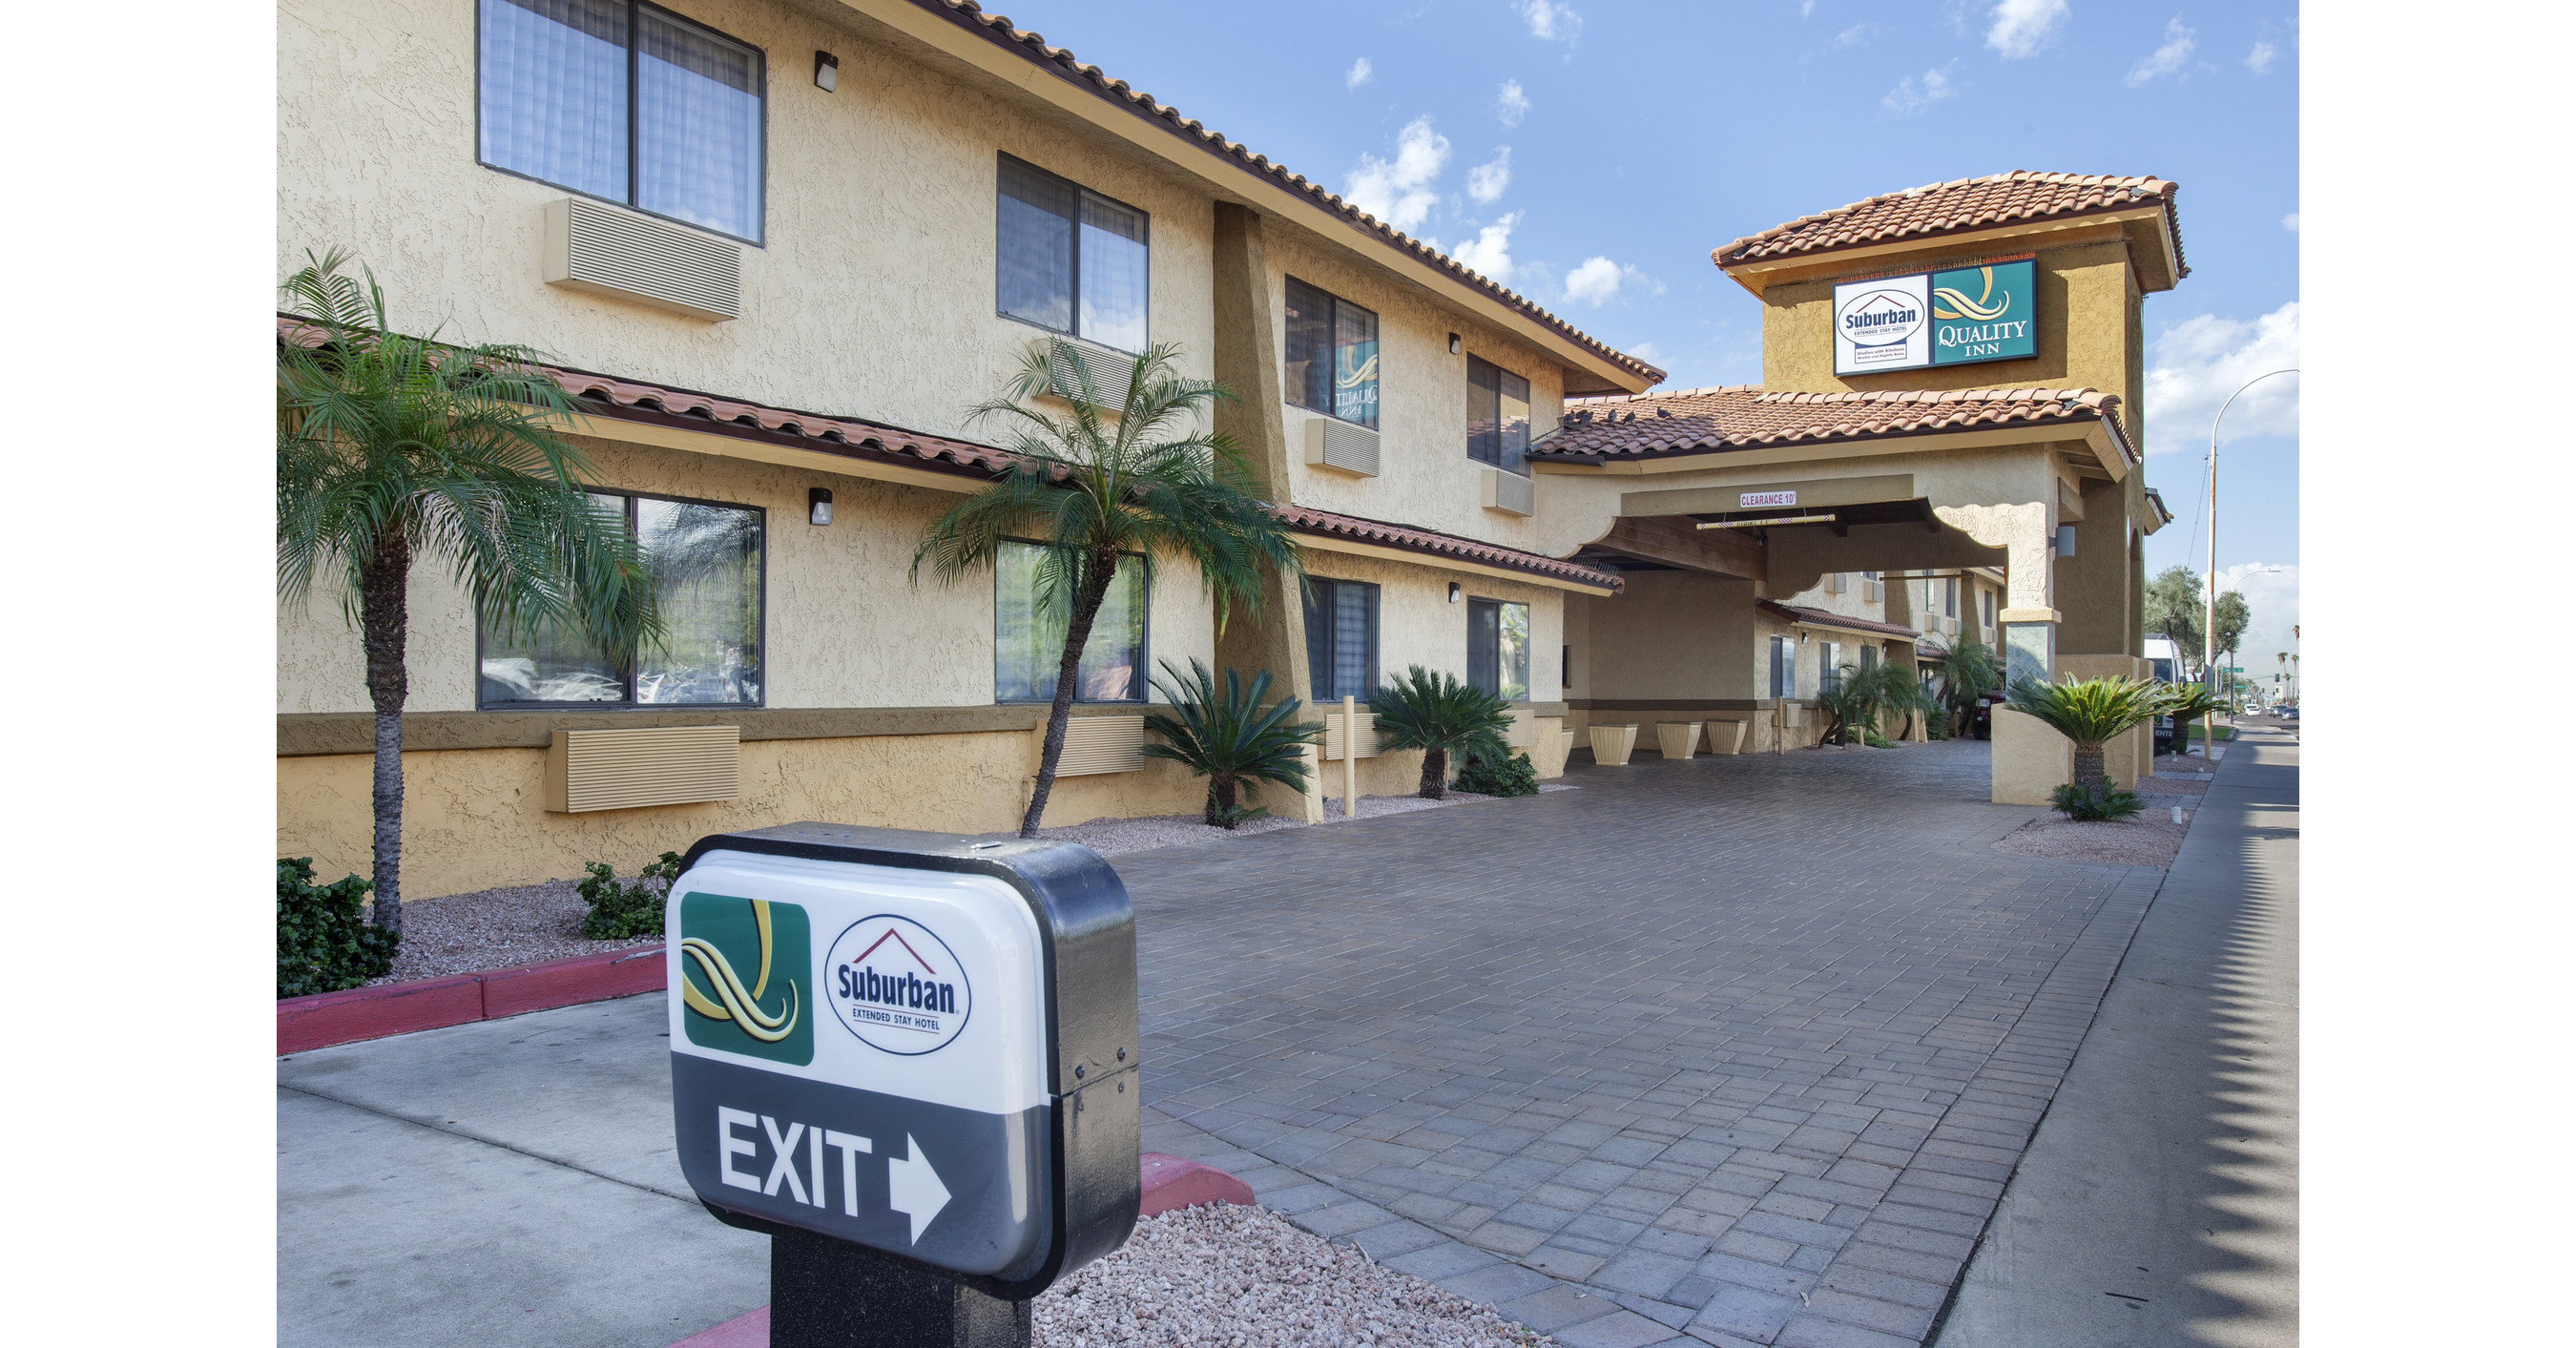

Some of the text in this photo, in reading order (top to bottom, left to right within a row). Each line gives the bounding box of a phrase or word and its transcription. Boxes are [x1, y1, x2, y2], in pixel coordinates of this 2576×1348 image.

[1846, 309, 1916, 329] Suburban
[1939, 321, 2027, 347] QUALITY
[1965, 342, 1999, 357] INN
[1741, 494, 1783, 506] CLEARANCE
[839, 964, 955, 1014] Suburban
[853, 1008, 940, 1030] EXTENDED STAY HOTEL
[718, 1106, 872, 1217] EXIT
